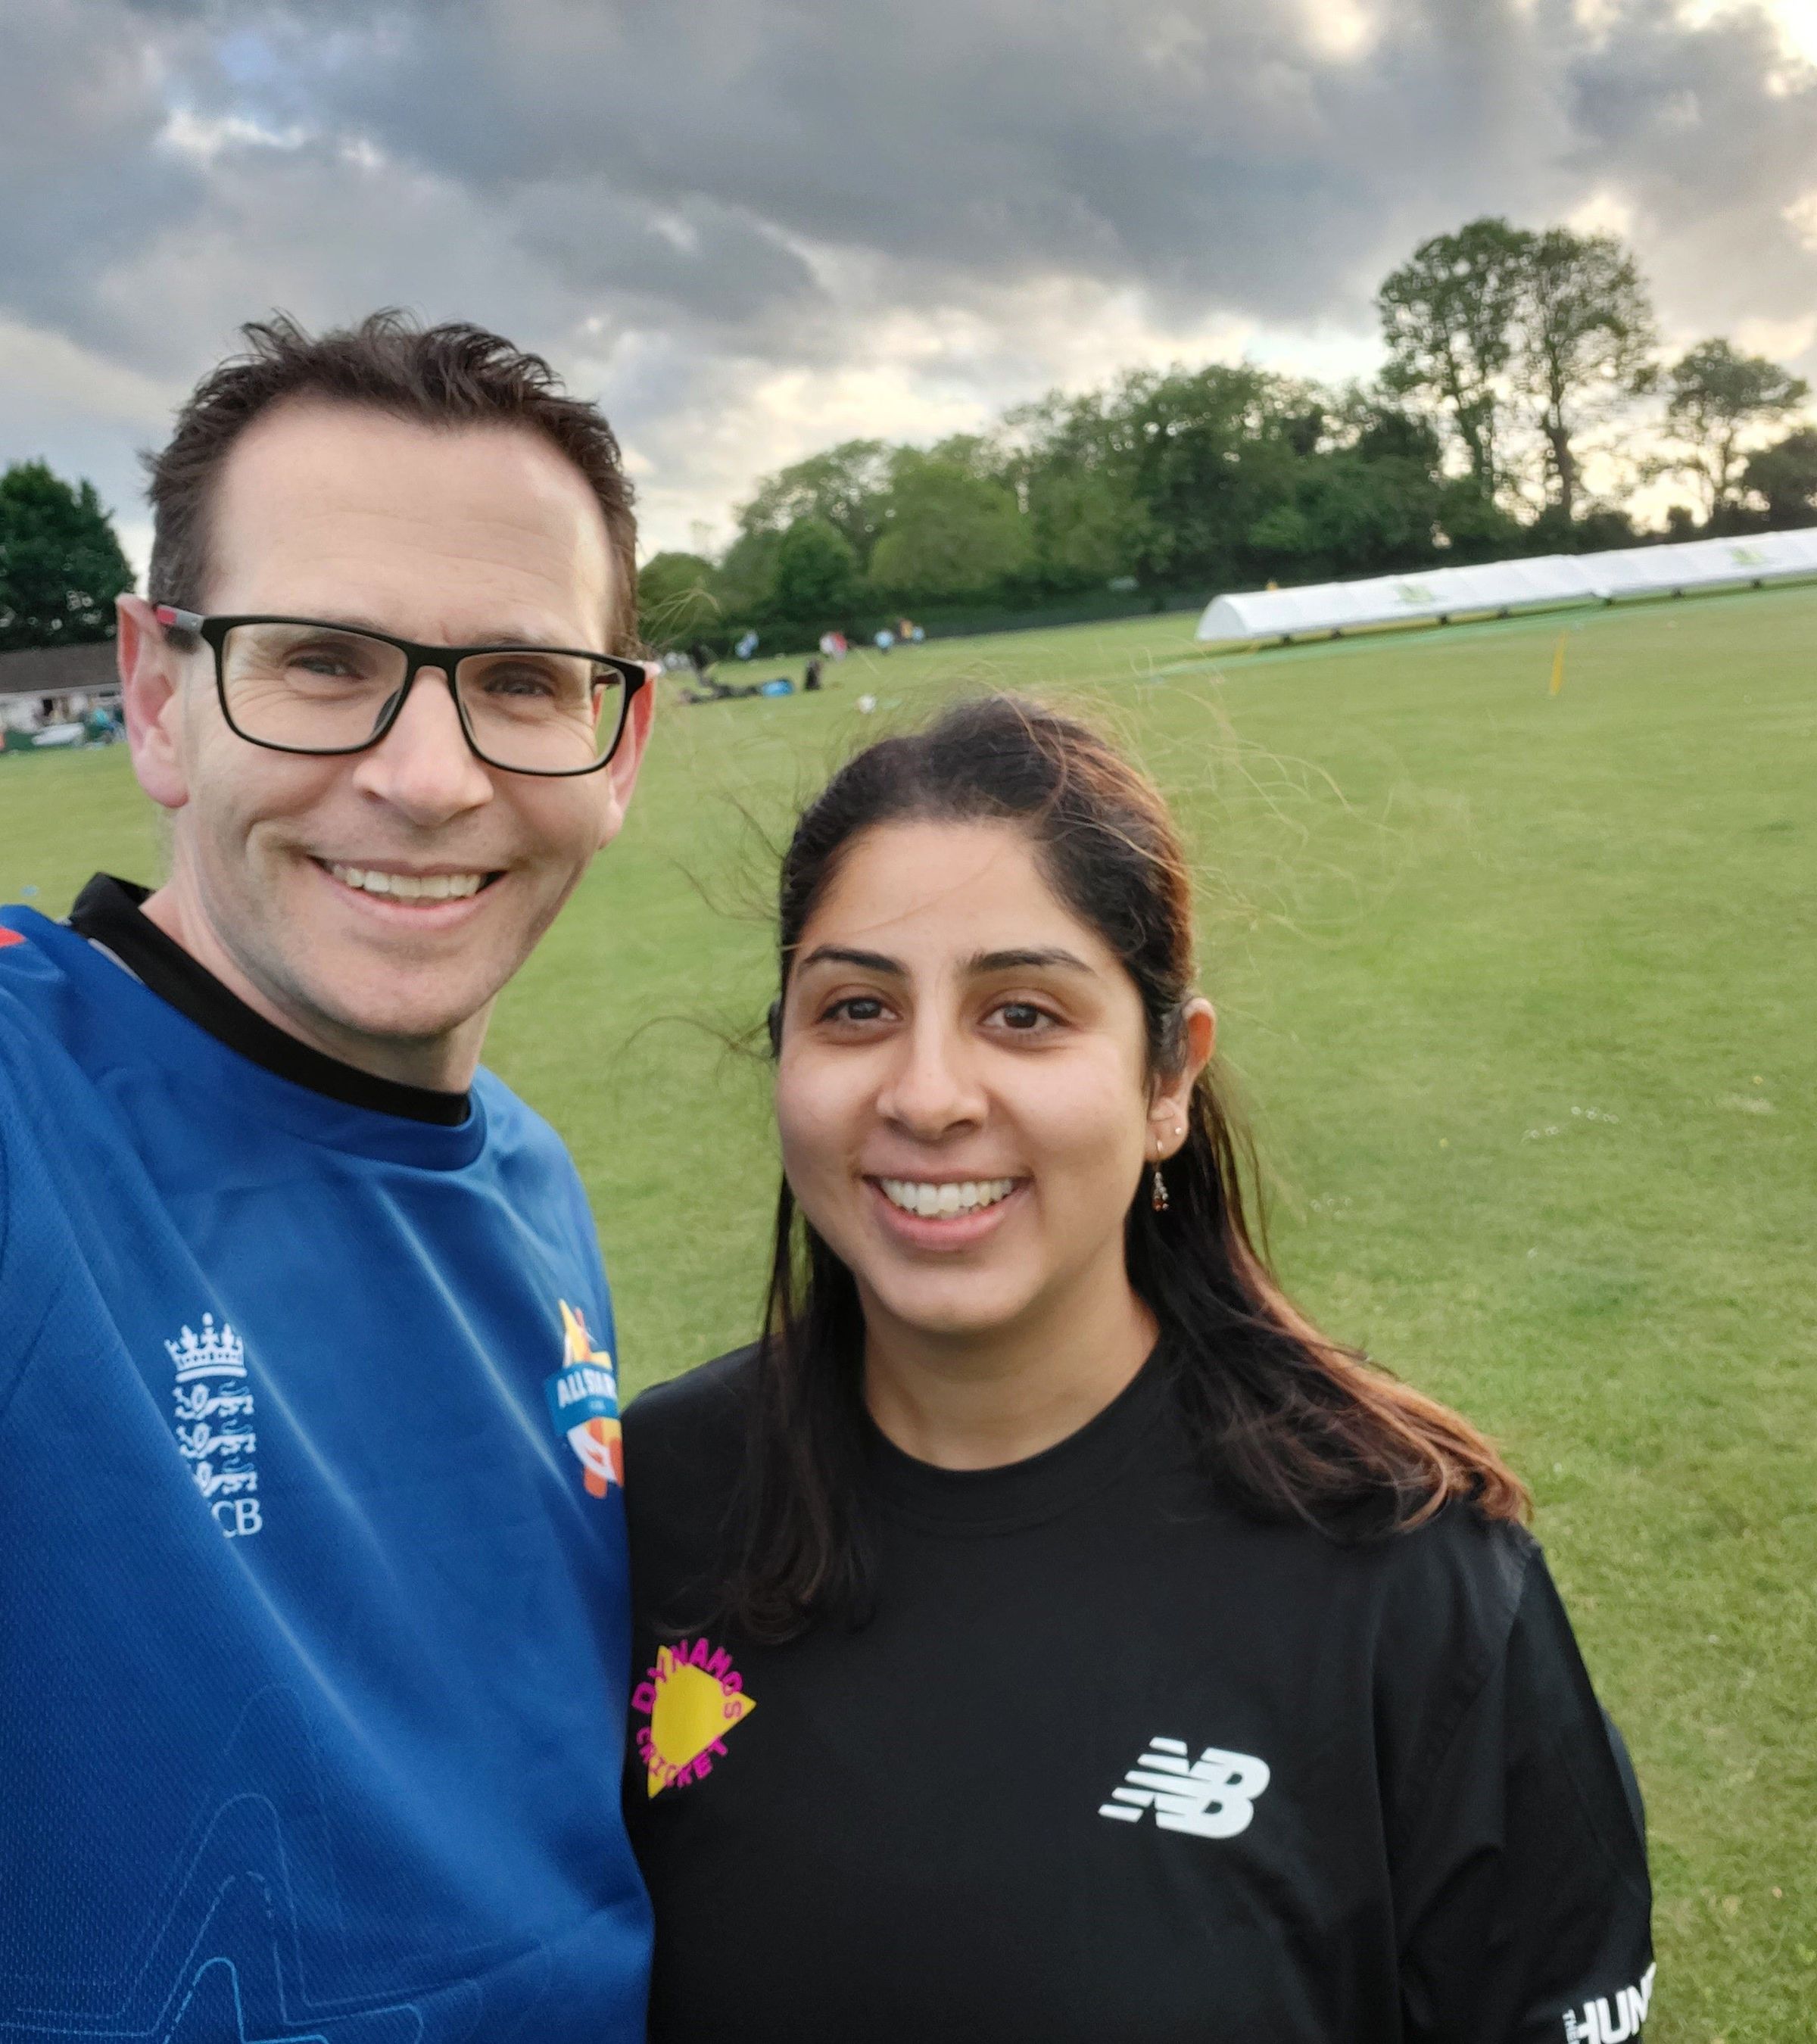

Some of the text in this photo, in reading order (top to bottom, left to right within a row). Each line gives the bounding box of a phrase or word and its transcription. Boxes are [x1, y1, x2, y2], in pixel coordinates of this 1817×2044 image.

[557, 1370, 587, 1408] ALL
[211, 1498, 263, 1538] CB
[631, 1637, 743, 1719] DYNAMOS
[637, 1727, 728, 1788] CRICKET
[1098, 1737, 1270, 1839] NB
